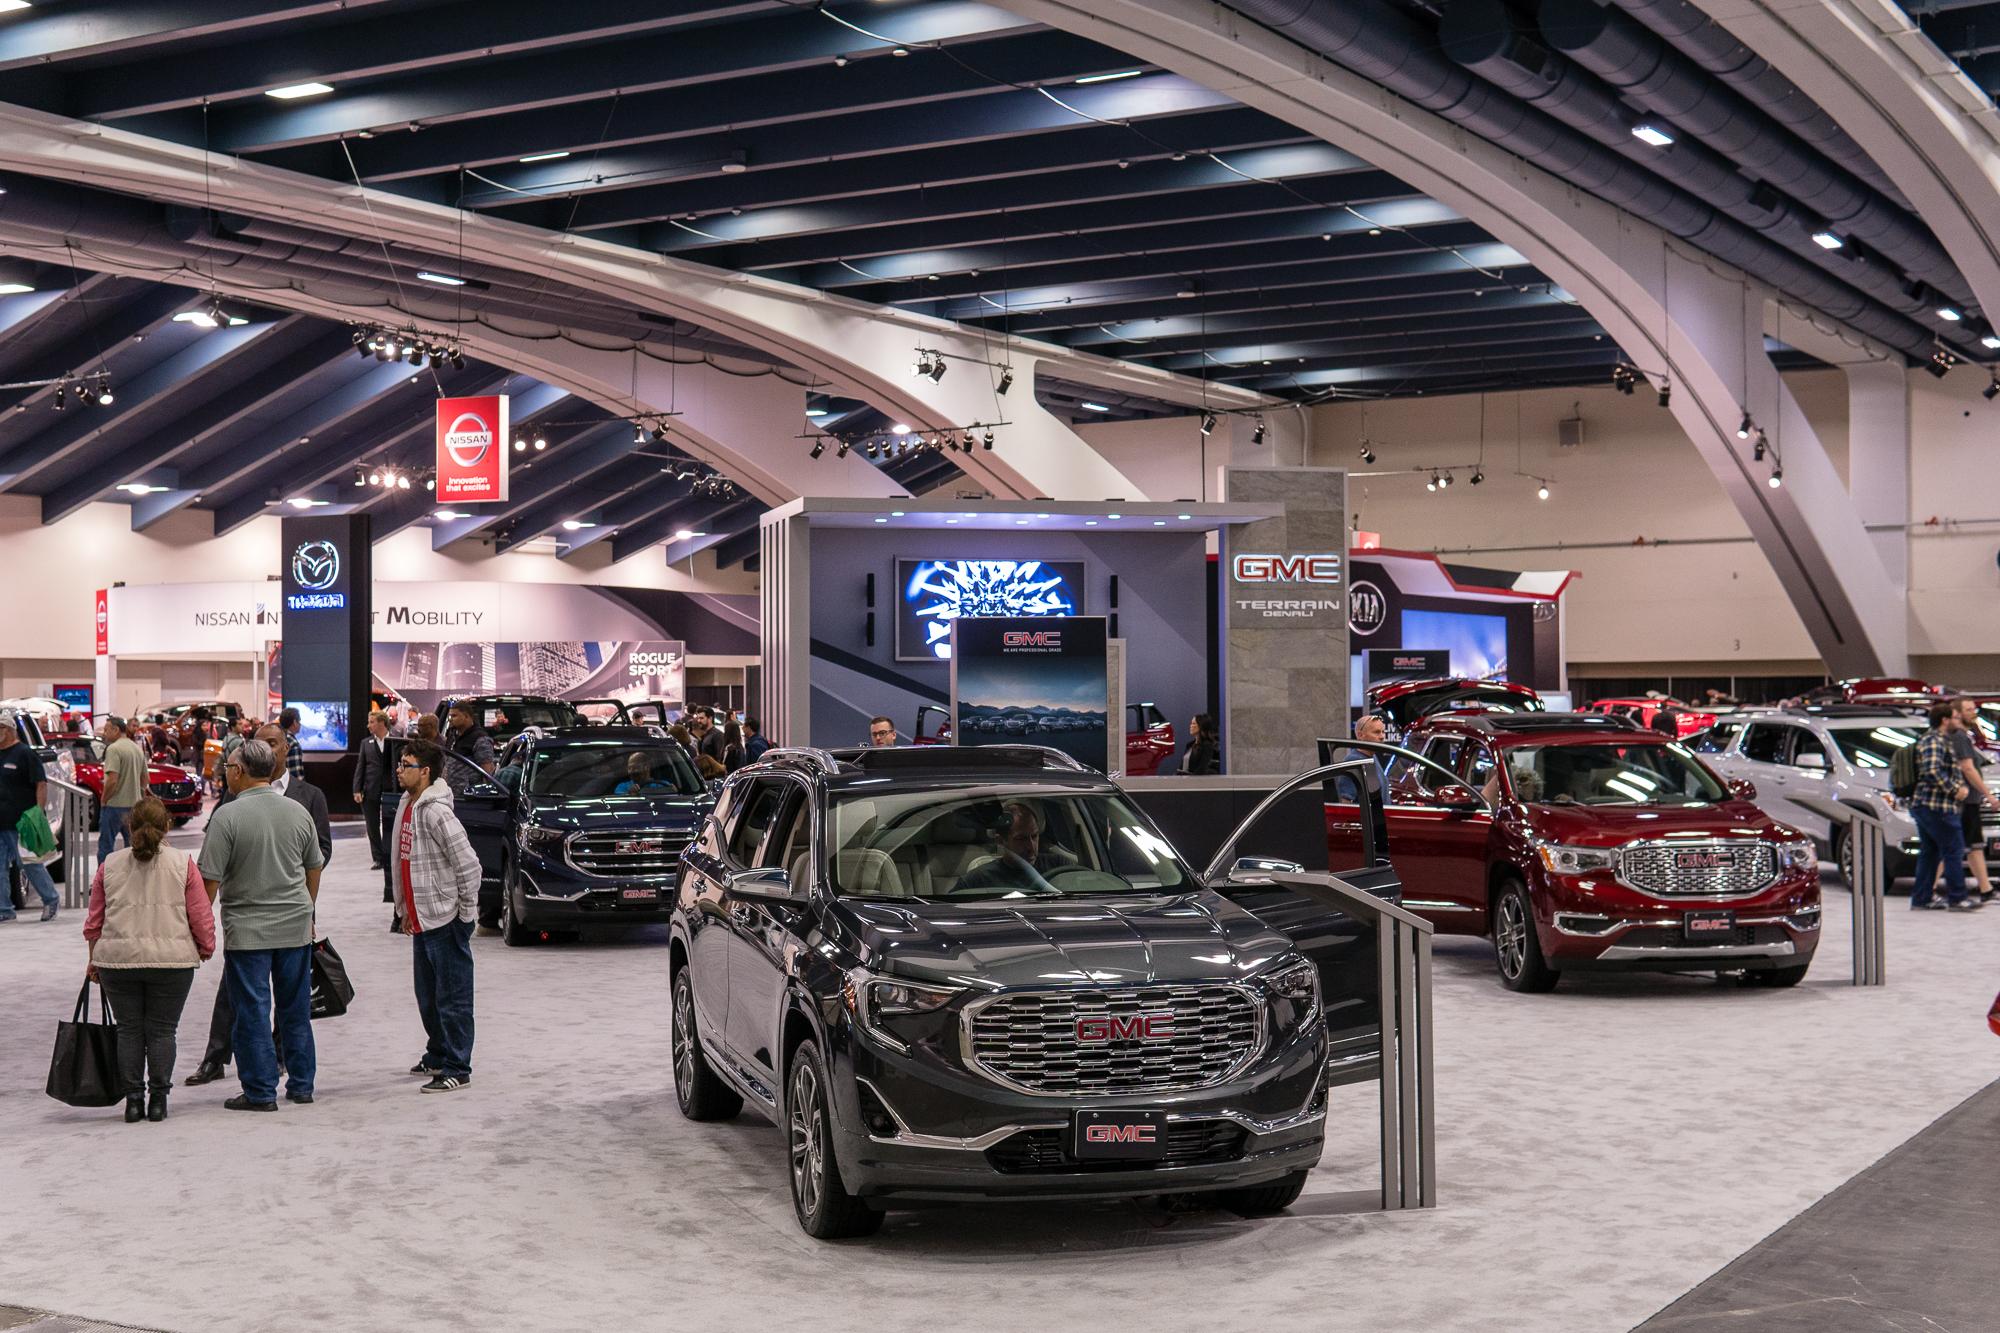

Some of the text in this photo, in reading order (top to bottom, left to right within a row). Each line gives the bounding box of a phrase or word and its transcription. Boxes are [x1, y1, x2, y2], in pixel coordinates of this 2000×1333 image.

[450, 434, 488, 444] NISSAN
[449, 476, 488, 485] Innovation
[446, 484, 491, 492] that excites
[1234, 554, 1341, 583] GMC
[1236, 600, 1340, 610] TERRAIN
[1351, 593, 1379, 623] KIA
[195, 612, 250, 626] NISSAN
[1004, 631, 1061, 646] GMC
[629, 652, 676, 664] ROGUE
[1393, 657, 1426, 667] GMC
[629, 664, 673, 676] SPORT
[615, 839, 662, 853] GMC
[1678, 854, 1732, 867] GMC
[623, 889, 657, 899] GMC
[1691, 919, 1731, 930] GMC
[1075, 1015, 1174, 1041] GMC
[1086, 1124, 1156, 1143] GMC
